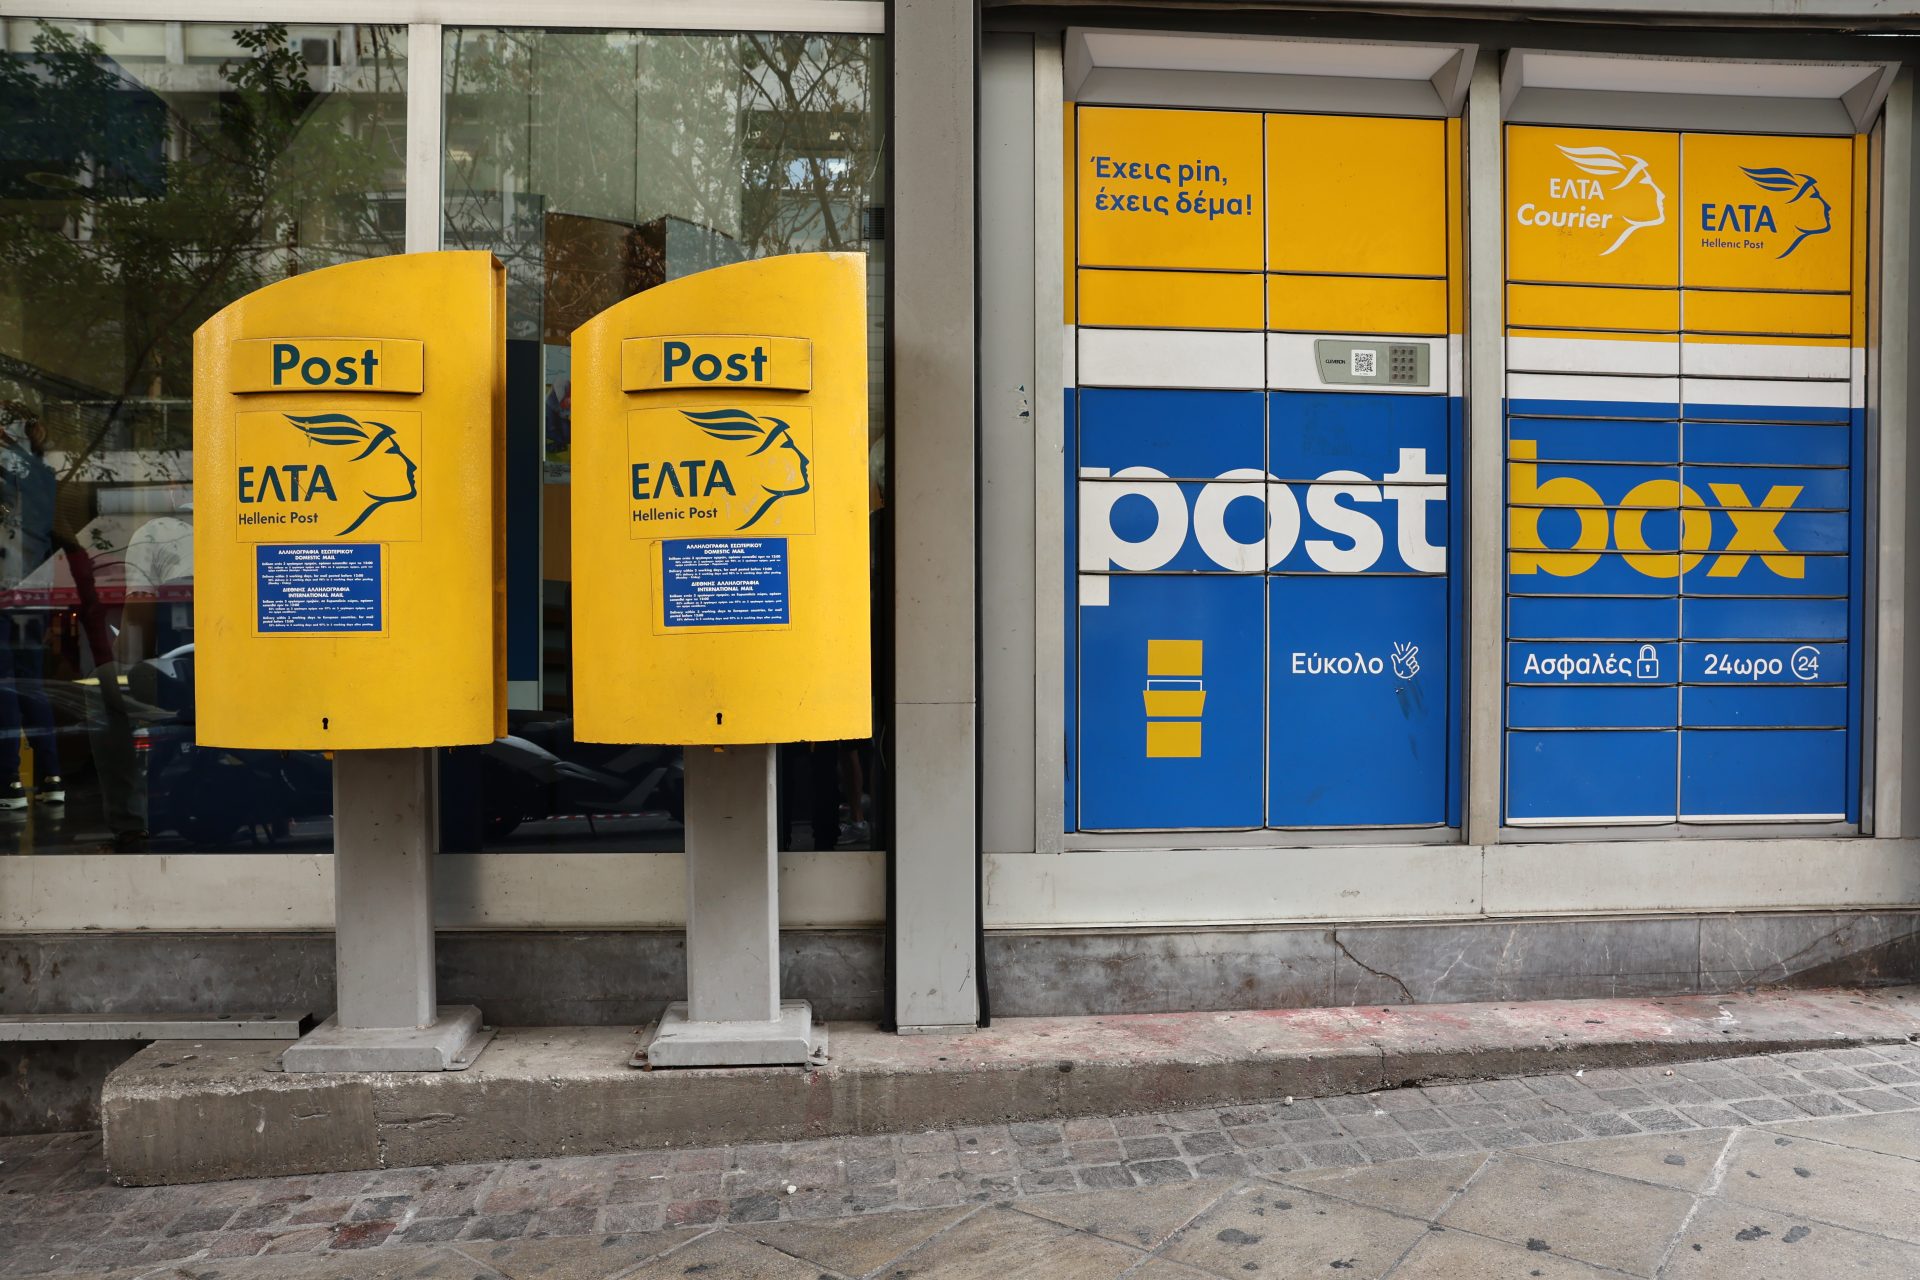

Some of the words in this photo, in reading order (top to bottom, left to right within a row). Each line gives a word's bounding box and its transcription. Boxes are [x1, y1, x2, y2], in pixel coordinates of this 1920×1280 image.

[1090, 156, 1172, 184] Έχεις
[1178, 160, 1228, 187] pin,
[1094, 186, 1169, 216] έχεις
[1176, 189, 1252, 221] δέμα!
[1549, 178, 1604, 201] ΕΛΤΑ
[1516, 203, 1613, 230] Courier
[1701, 203, 1777, 233] ΕΛΤΑ
[1701, 238, 1741, 249] Hellenic
[1743, 239, 1764, 250] Post
[272, 343, 379, 386] Post
[663, 341, 767, 382] Post
[238, 464, 338, 503] ΕΛΤΑ
[631, 460, 736, 500] ΕΛΤΑ
[238, 511, 287, 525] Hellenic
[290, 510, 319, 524] Post
[632, 508, 686, 522] Hellenic
[688, 507, 718, 520] Post
[1509, 439, 1805, 579] box
[1080, 447, 1447, 607] post
[1291, 651, 1384, 675] Εύκολο
[1523, 651, 1633, 680] Ασφαλές
[1704, 653, 1783, 681] 24ωρο
[1798, 656, 1820, 671] 24
